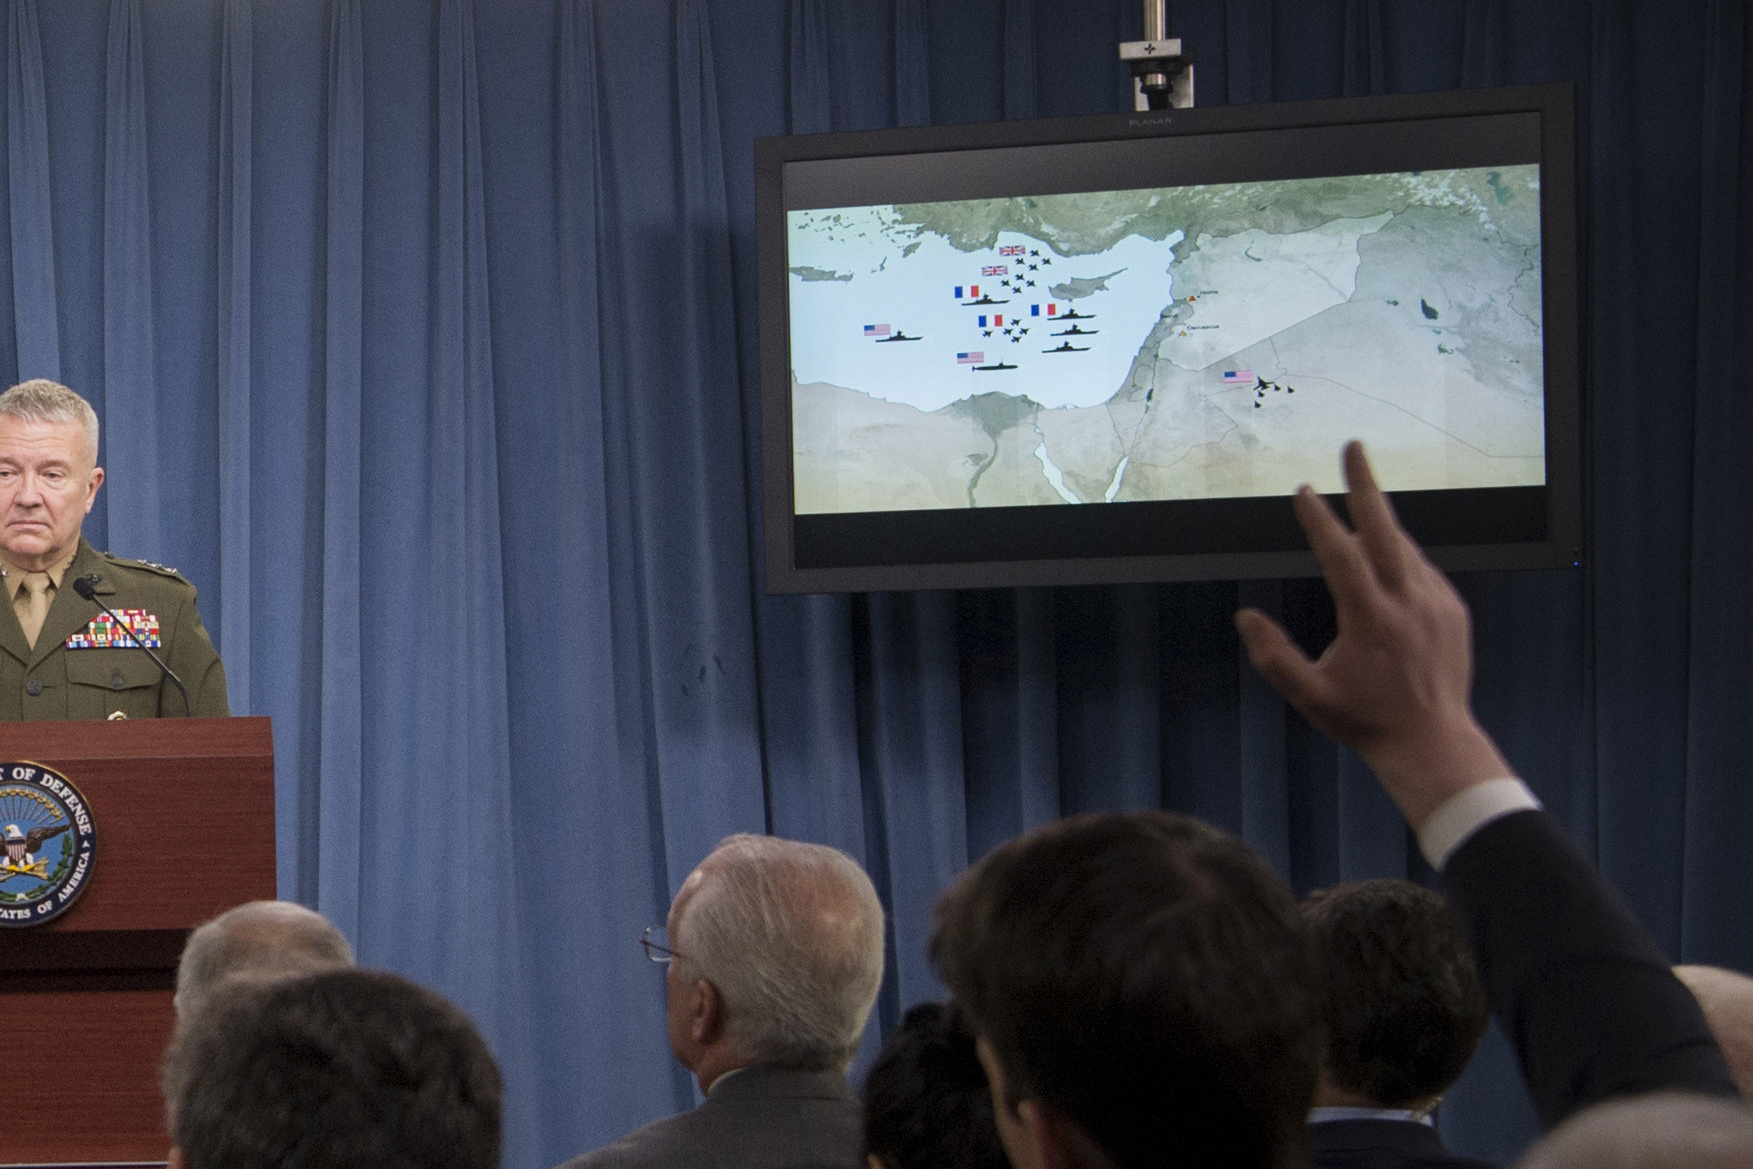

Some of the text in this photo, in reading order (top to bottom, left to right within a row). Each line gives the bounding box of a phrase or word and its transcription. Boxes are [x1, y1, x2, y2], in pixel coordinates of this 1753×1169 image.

[12, 767, 36, 781] OF
[39, 774, 92, 836] DEFENSE
[37, 900, 53, 914] OF
[58, 851, 90, 902] AMERICA
